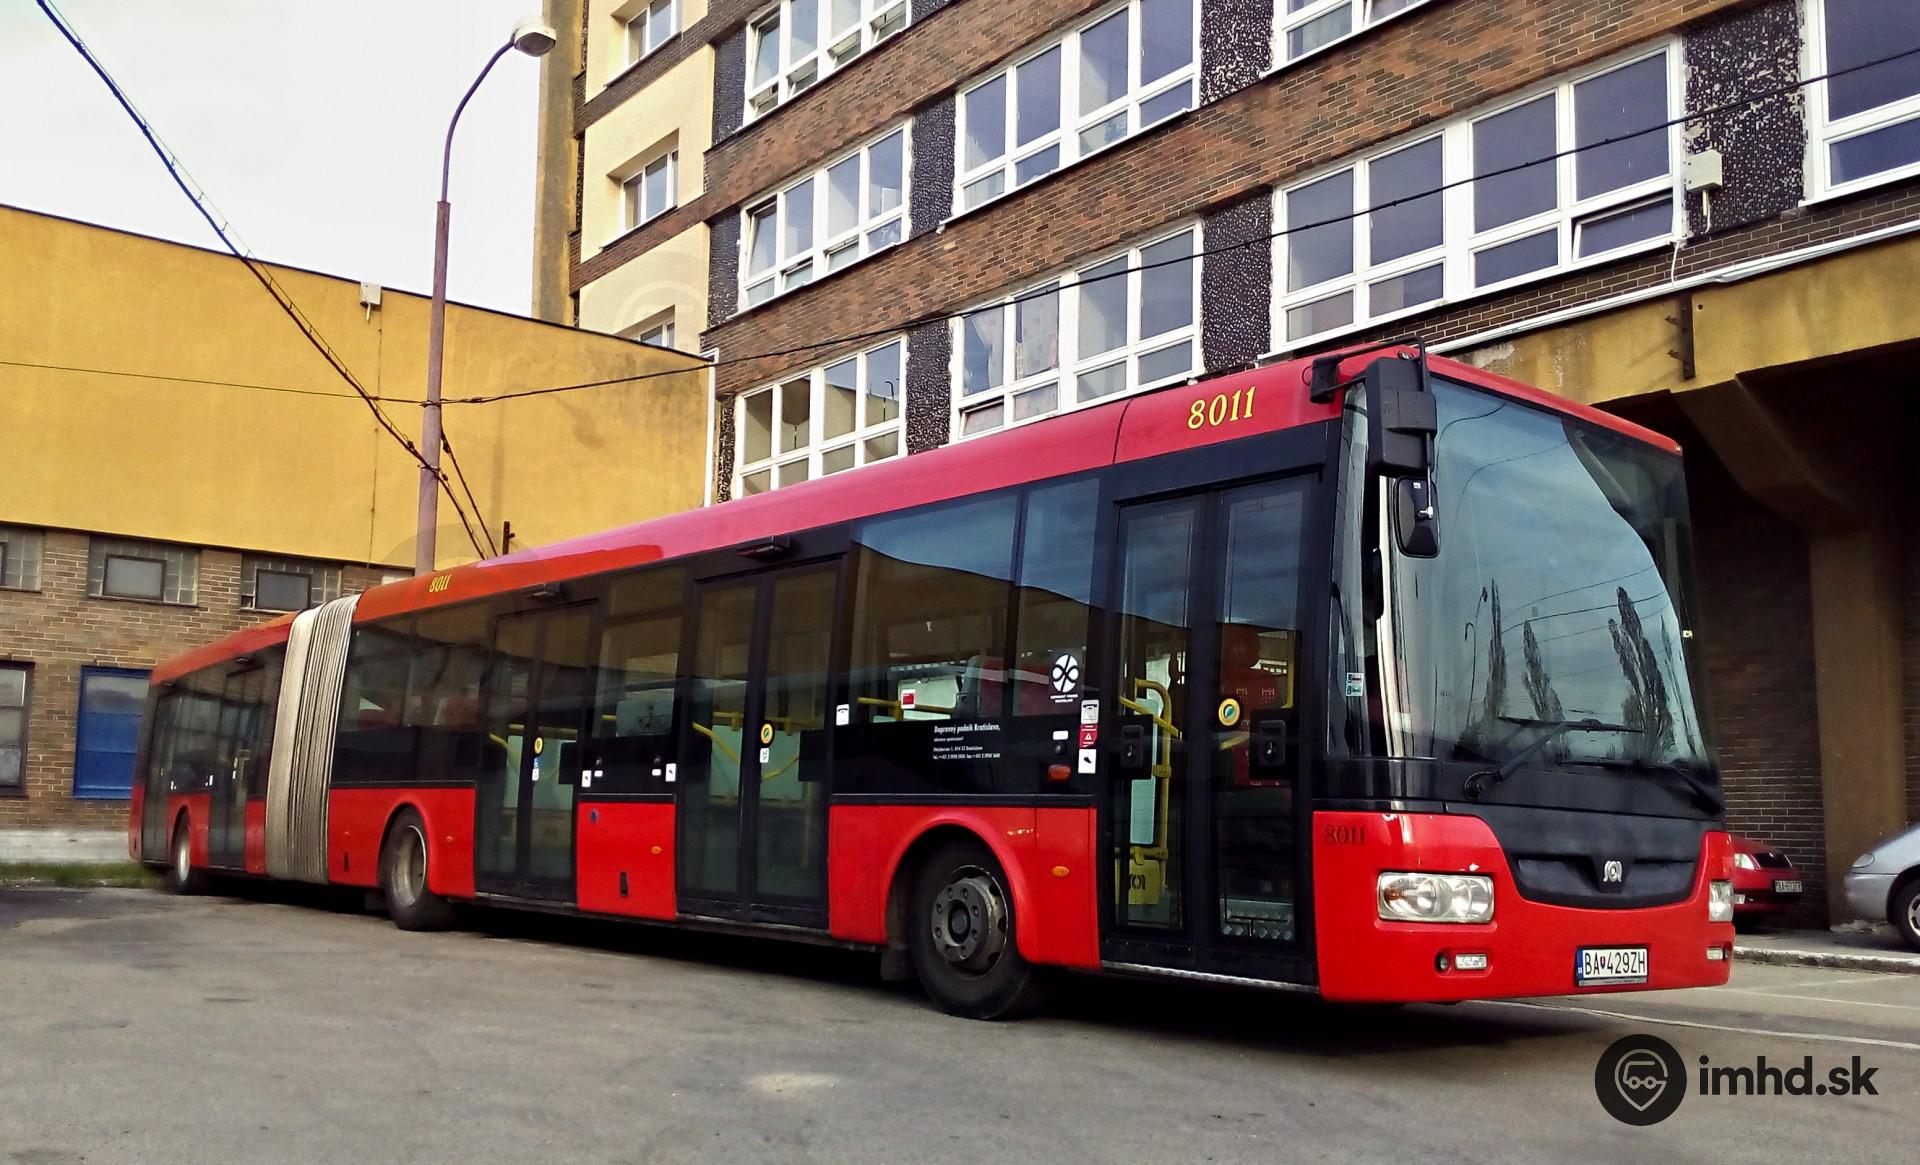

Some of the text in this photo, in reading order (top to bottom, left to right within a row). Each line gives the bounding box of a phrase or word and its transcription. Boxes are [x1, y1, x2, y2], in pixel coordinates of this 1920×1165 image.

[1187, 385, 1257, 430] 8011
[429, 574, 452, 593] 8011
[1324, 823, 1366, 846] 8011
